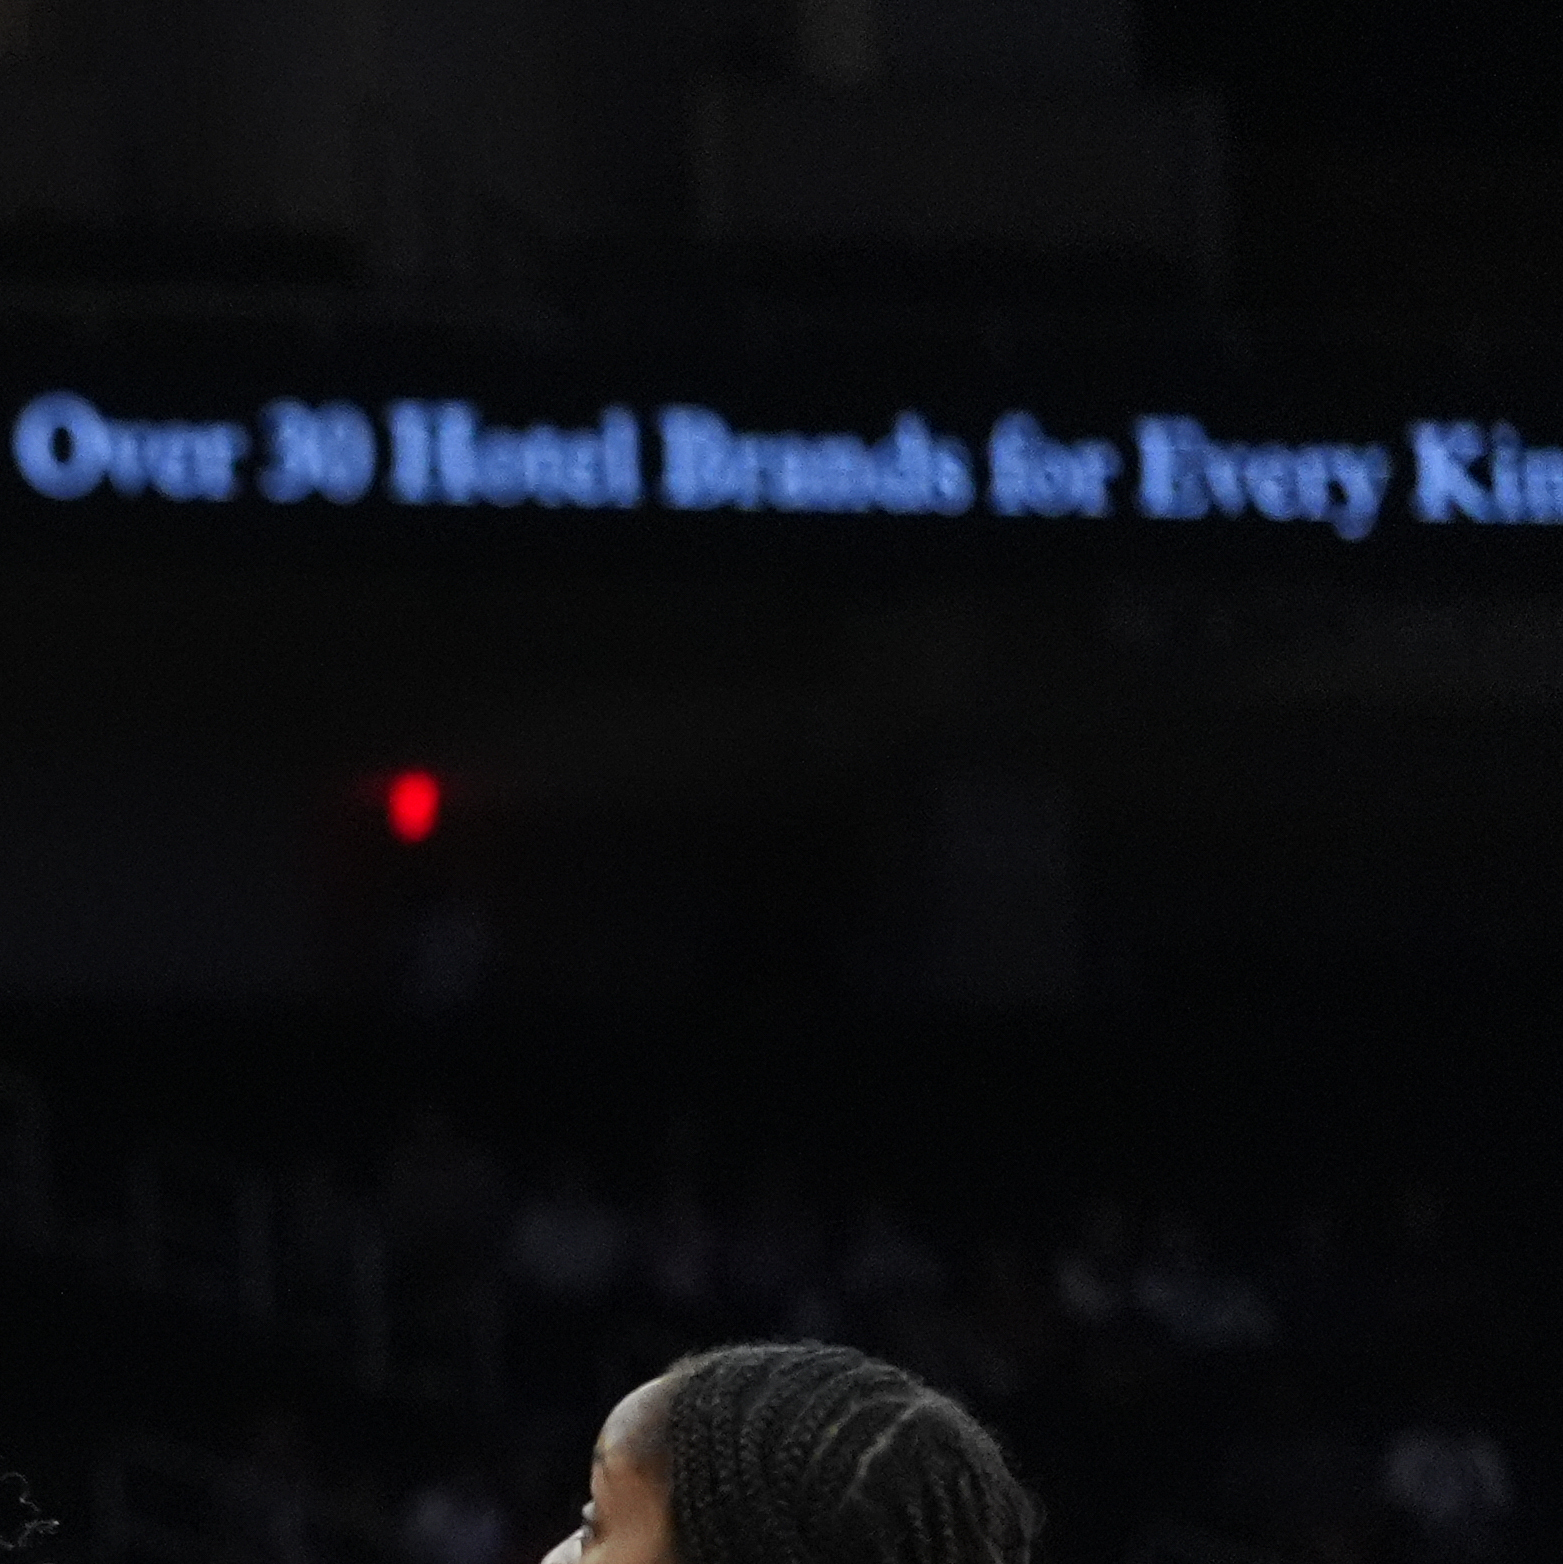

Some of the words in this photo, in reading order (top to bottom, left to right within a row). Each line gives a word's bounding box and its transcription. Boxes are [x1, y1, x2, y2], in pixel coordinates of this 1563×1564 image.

[13, 392, 245, 500] Over
[260, 400, 373, 502] 30
[388, 400, 641, 507] Hotel
[661, 403, 970, 515] Brands
[988, 410, 1119, 517] for
[1135, 414, 1387, 540] Every
